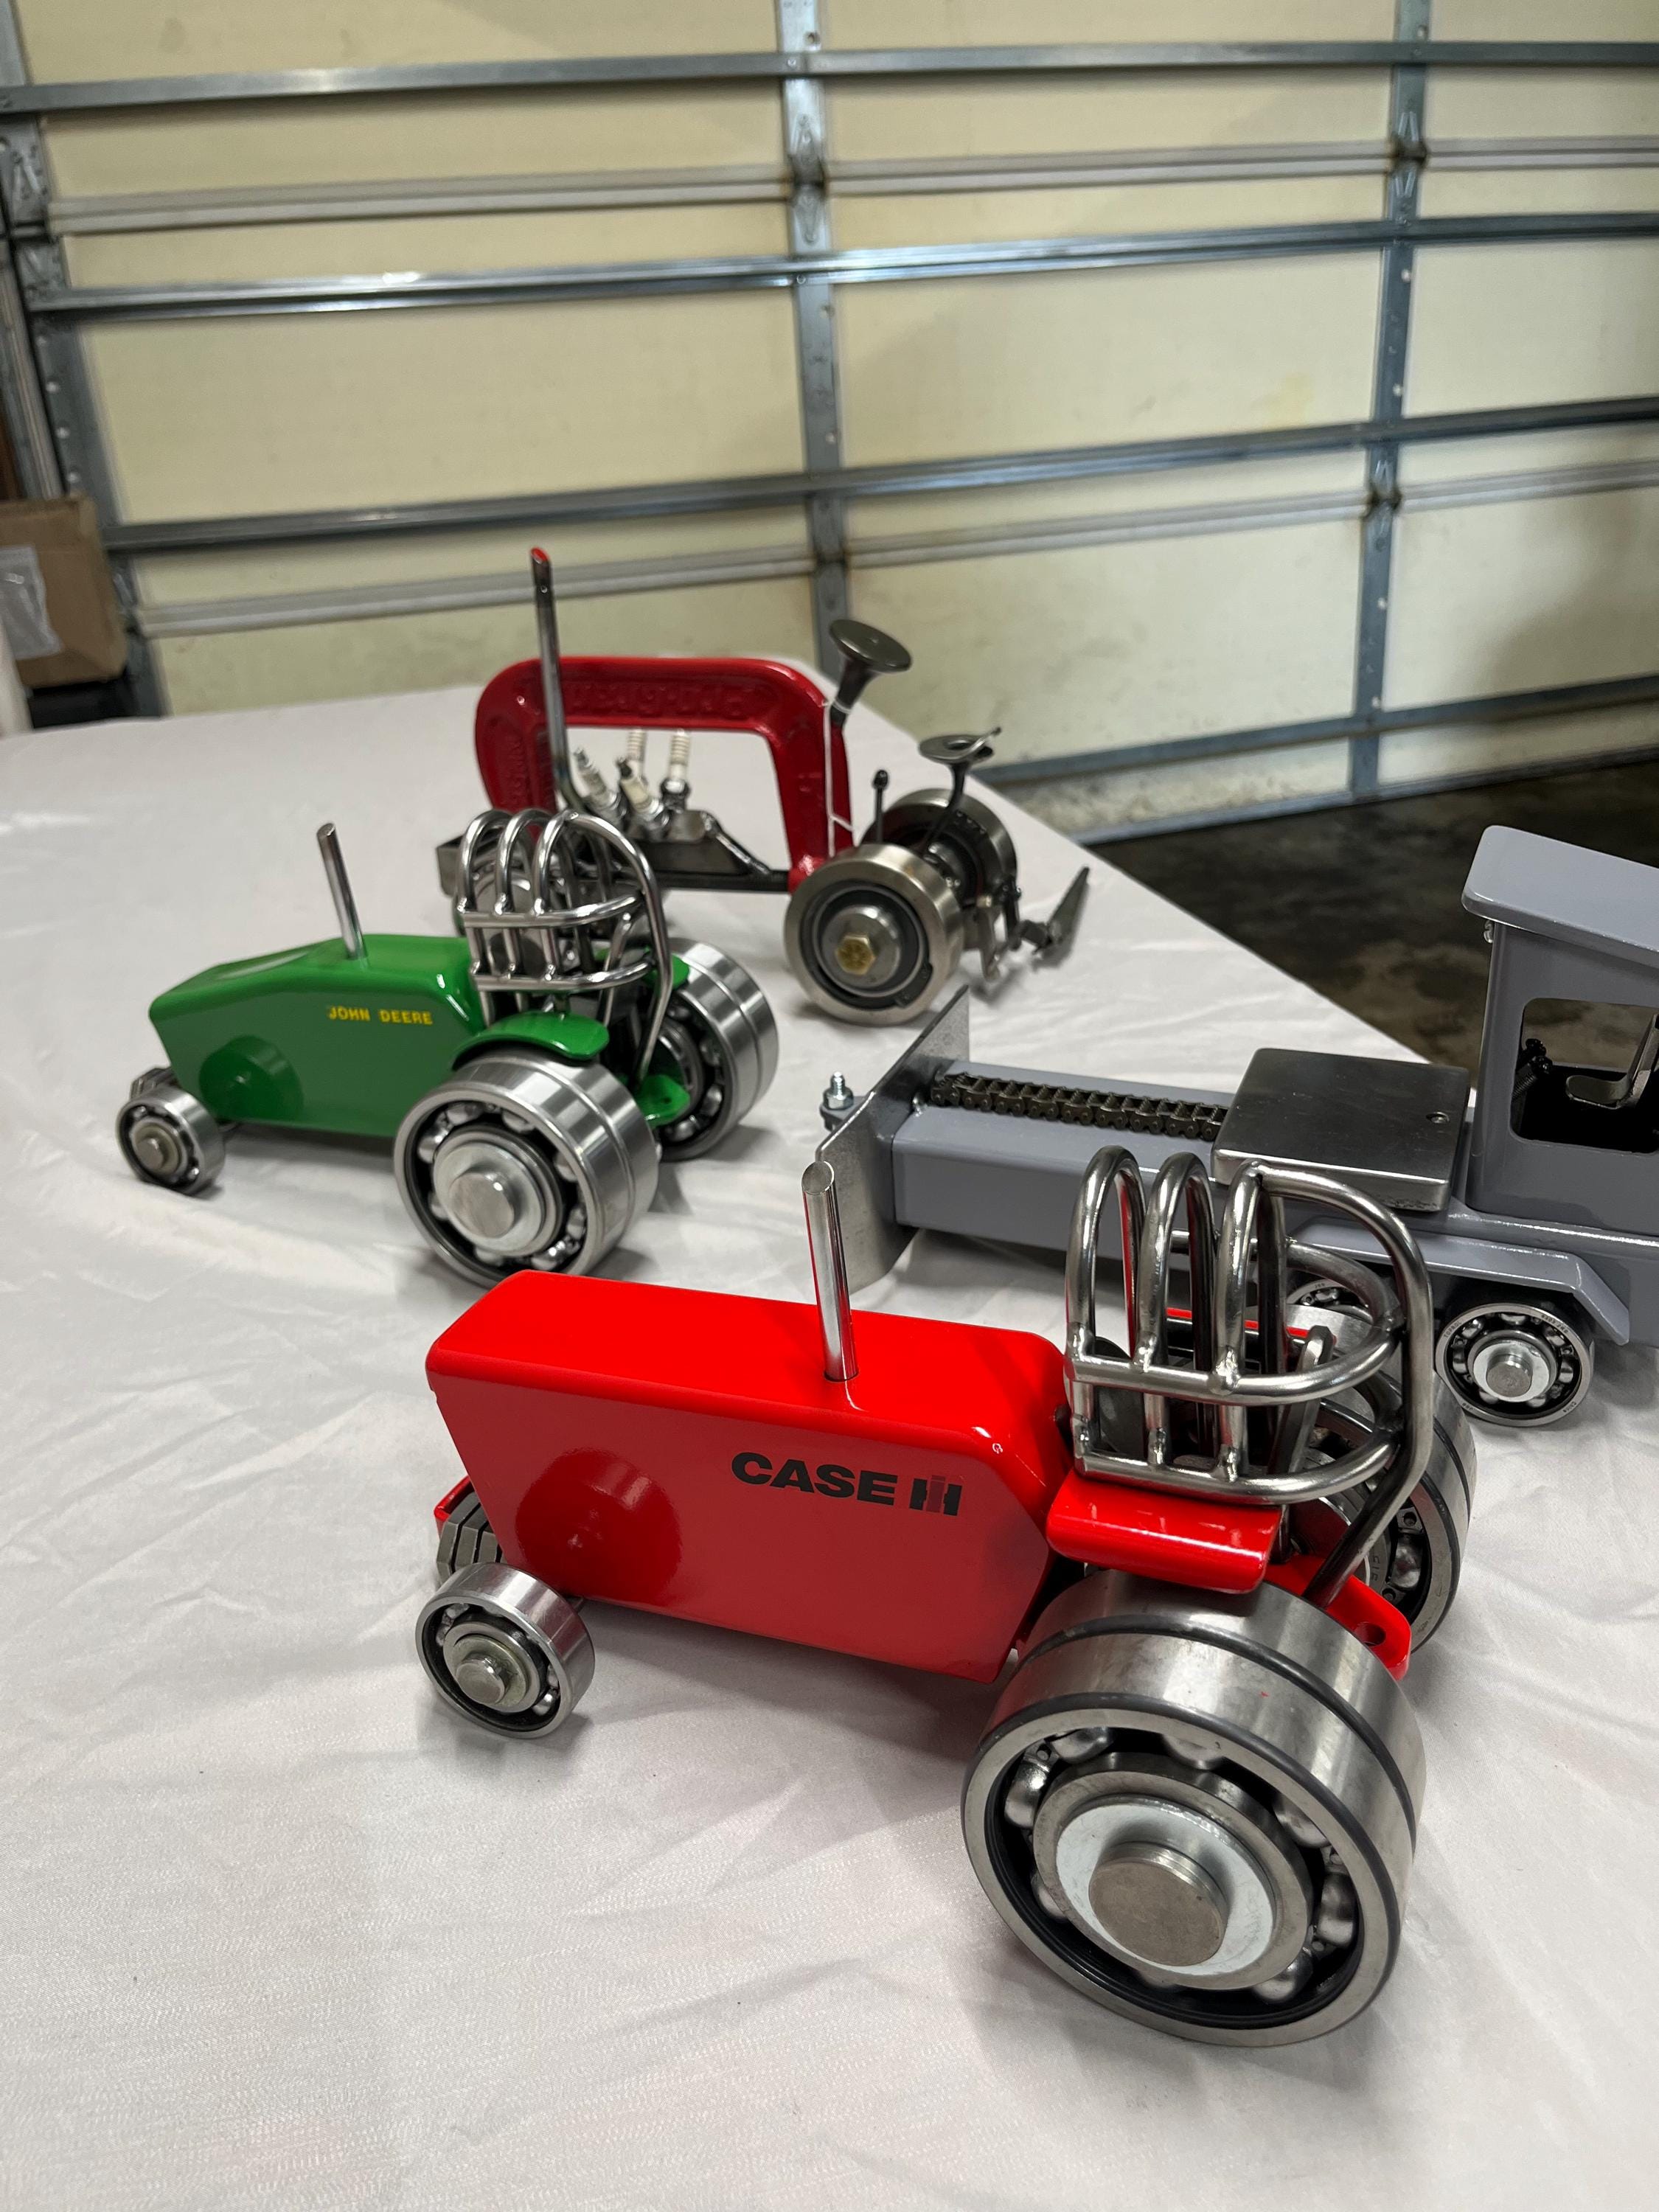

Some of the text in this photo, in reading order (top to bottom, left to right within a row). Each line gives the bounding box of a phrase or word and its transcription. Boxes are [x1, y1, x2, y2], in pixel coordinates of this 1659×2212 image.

[328, 1006, 433, 1026] JOHN DEERE
[731, 1452, 897, 1506] CASE
